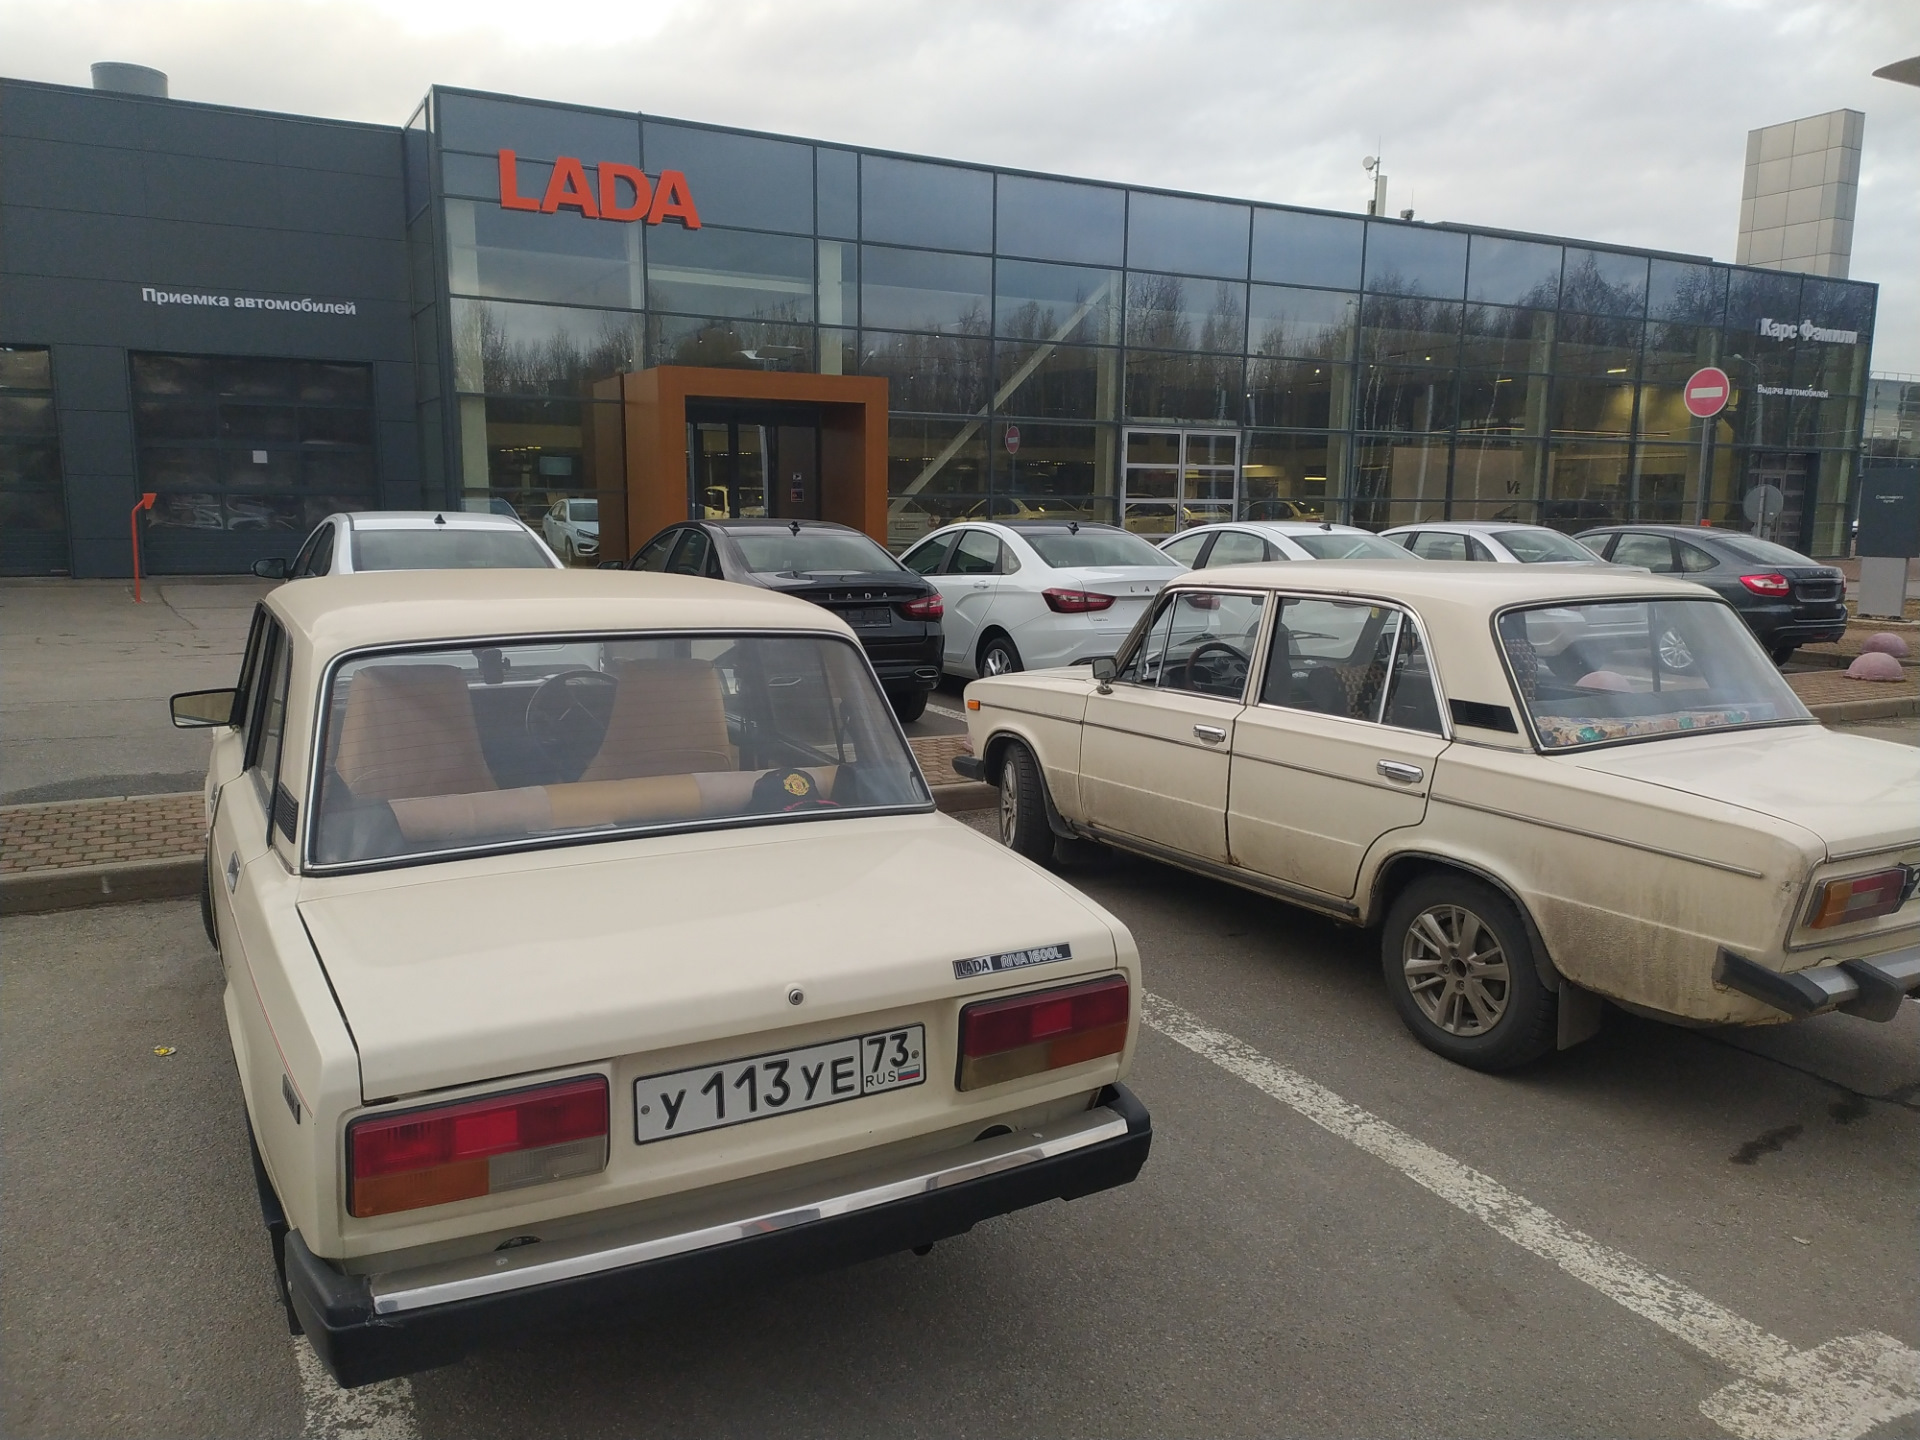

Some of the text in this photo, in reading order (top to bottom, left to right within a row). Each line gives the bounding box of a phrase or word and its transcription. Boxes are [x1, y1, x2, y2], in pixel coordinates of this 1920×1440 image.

[498, 148, 702, 230] LADA
[141, 287, 357, 315] Приемка автомобилей
[1760, 318, 1858, 345] Карс Фэмили
[1757, 384, 1828, 399] Выдача автомобилей
[828, 591, 889, 601] LADA
[955, 958, 991, 977] LADA
[865, 1070, 897, 1088] RUS
